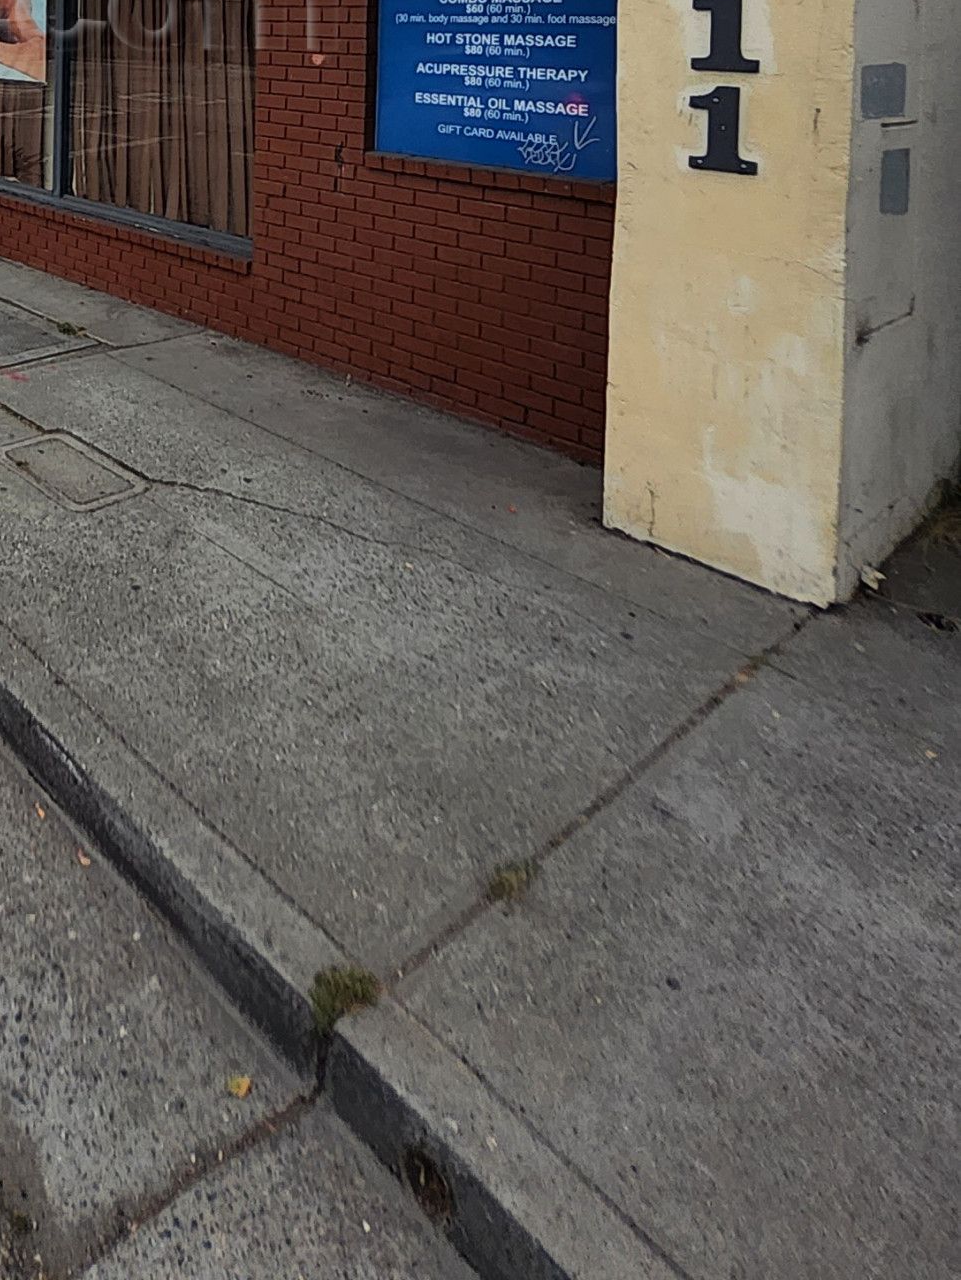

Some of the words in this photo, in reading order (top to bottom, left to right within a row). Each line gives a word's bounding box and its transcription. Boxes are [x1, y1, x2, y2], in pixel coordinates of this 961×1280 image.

[465, 4, 484, 14] $60
[486, 4, 503, 15] (60
[505, 4, 531, 15] min.)
[395, 14, 408, 25] (30
[410, 14, 427, 23] min.
[428, 14, 449, 25] body
[450, 15, 489, 26] massage
[491, 14, 508, 24] and
[509, 15, 523, 24] 30
[524, 14, 545, 24] min.
[547, 14, 567, 24] foot
[568, 15, 616, 27] massage
[426, 32, 453, 45] HOT
[455, 33, 500, 46] STONE
[504, 34, 577, 48] MASSAGE
[464, 45, 483, 55] $80
[485, 45, 502, 57] (60
[504, 46, 530, 58] min.)
[416, 62, 514, 78] ACUPRESSURE
[518, 67, 589, 83] THERAPY
[464, 76, 482, 86] $80
[484, 77, 501, 89] (60
[503, 78, 530, 91] min.)
[415, 91, 485, 108] ESSENTIAL
[488, 98, 511, 111] OIL
[514, 99, 589, 117] MASSAGE
[463, 108, 482, 118] $80
[484, 108, 501, 120] (60
[503, 110, 529, 124] min.)
[438, 123, 463, 135] GIFT
[463, 126, 494, 139] CARD
[496, 131, 558, 145] AVAILABLE
